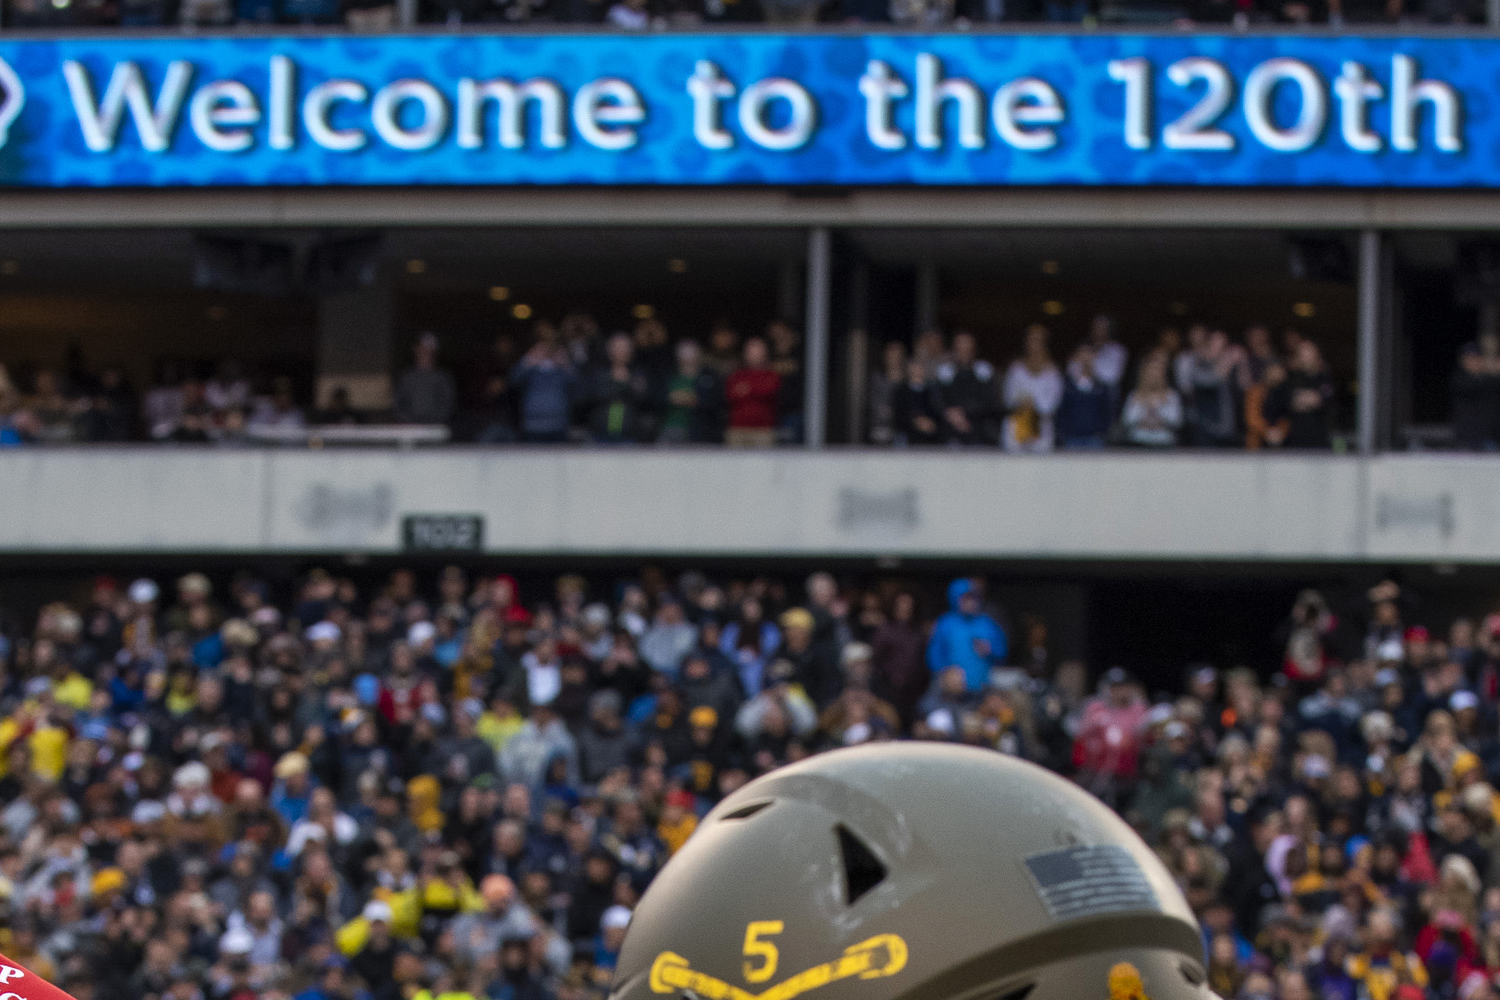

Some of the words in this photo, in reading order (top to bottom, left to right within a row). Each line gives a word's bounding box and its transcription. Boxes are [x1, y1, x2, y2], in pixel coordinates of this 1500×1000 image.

[63, 55, 645, 152] Welcome
[687, 59, 817, 151] to
[859, 53, 1065, 151] the
[1107, 53, 1462, 153] 120th
[742, 920, 784, 983] 5
